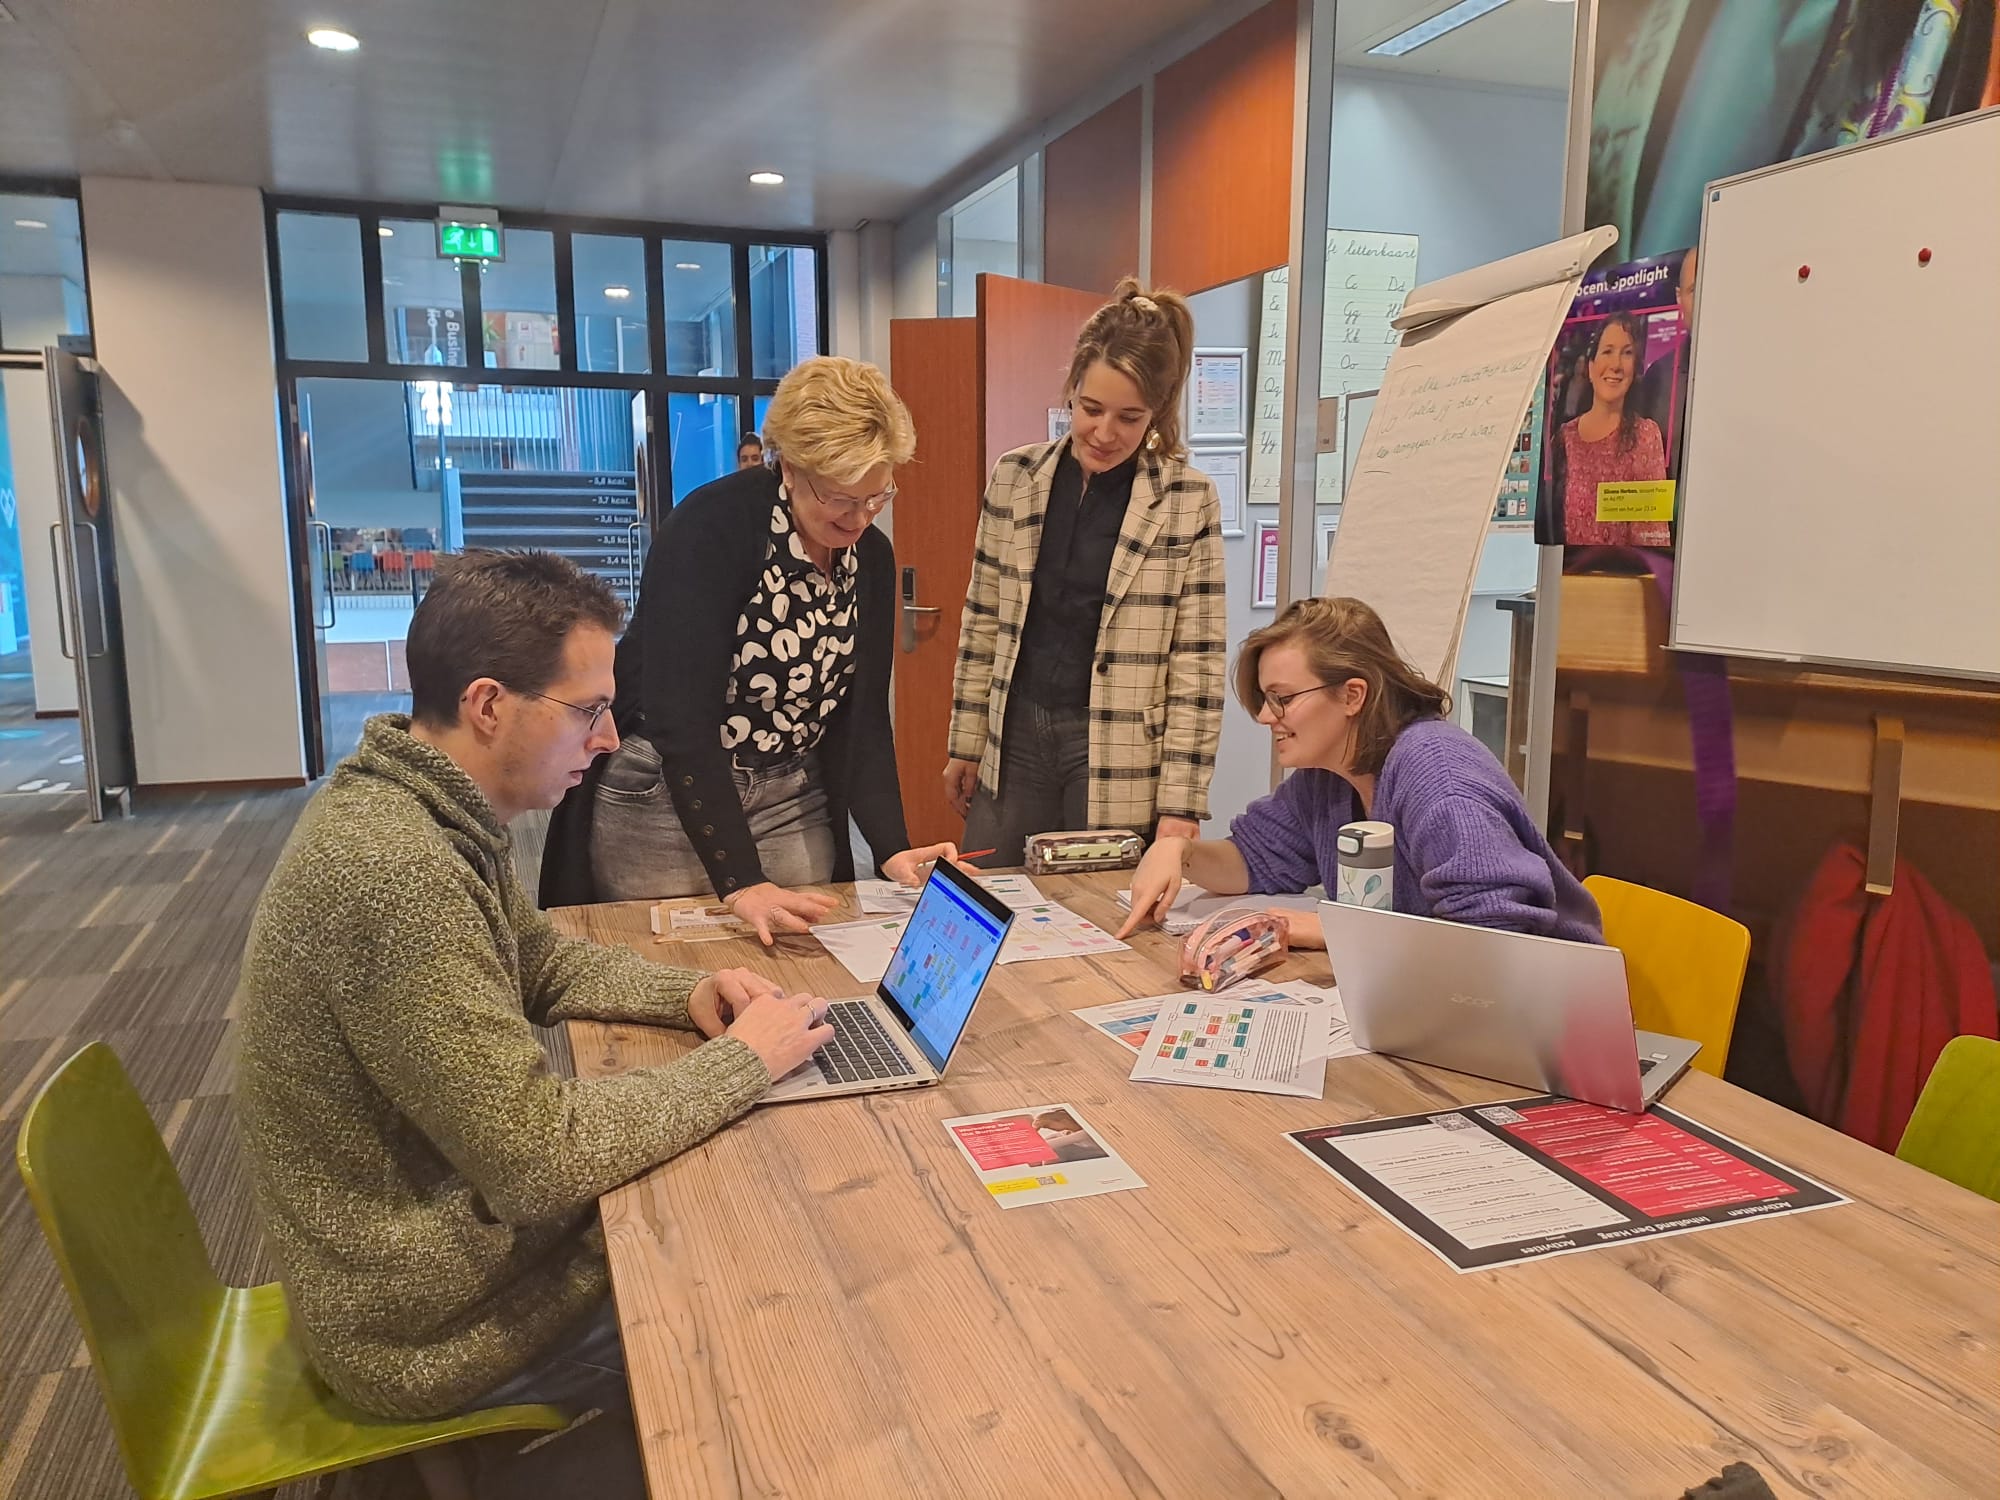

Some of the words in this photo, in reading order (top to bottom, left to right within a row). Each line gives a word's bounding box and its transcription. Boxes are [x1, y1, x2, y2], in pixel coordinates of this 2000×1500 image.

[1344, 240, 1417, 259] letterkaart
[1576, 281, 1609, 298] ocent
[1632, 1225, 1656, 1235] Den
[1655, 1216, 1710, 1231] Inholland
[1597, 1229, 1632, 1240] Haag
[1520, 1240, 1576, 1254] Activities
